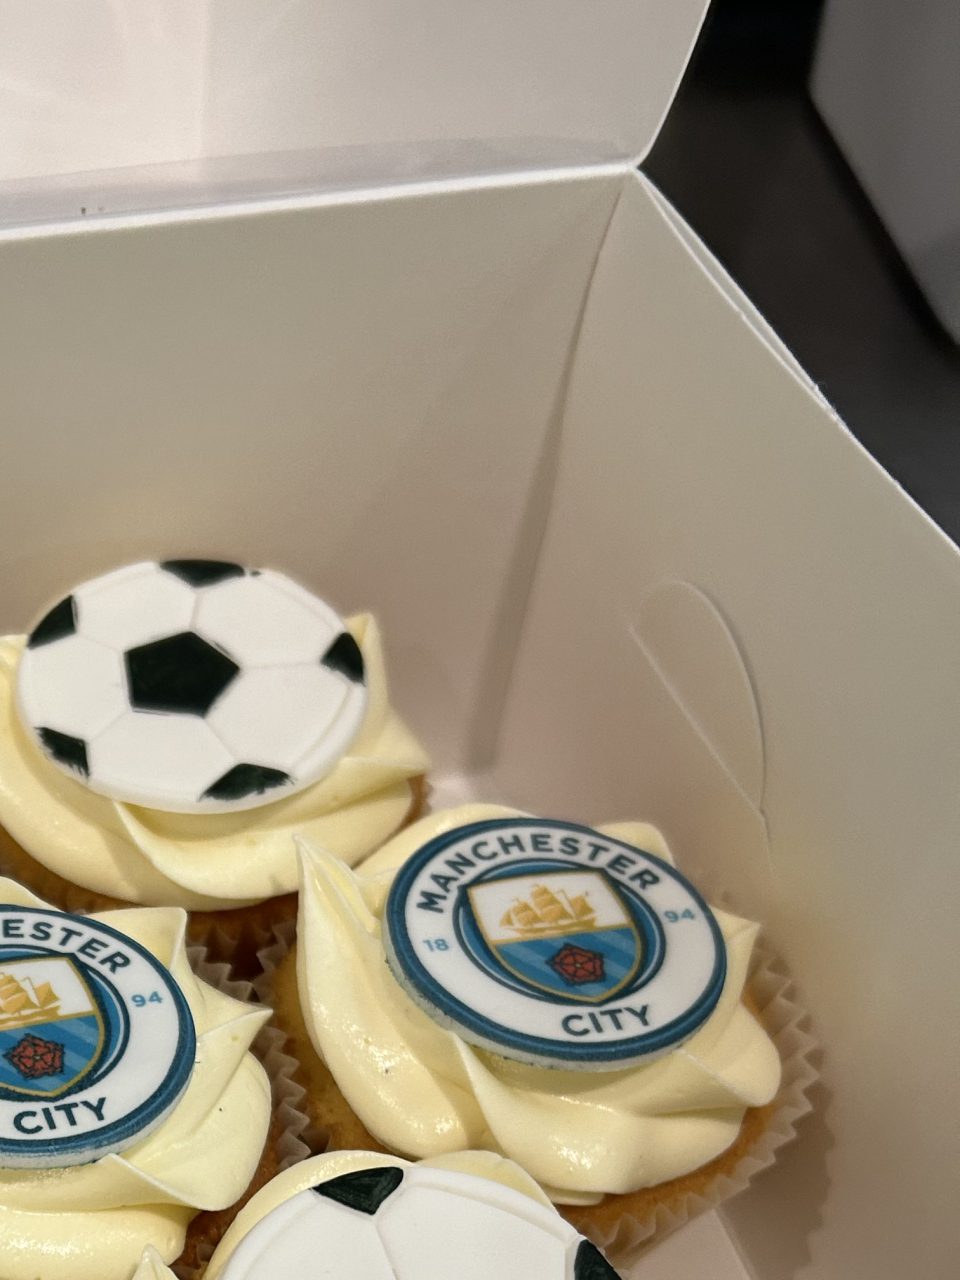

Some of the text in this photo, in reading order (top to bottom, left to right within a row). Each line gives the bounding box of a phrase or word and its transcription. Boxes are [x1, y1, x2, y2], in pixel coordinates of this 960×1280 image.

[417, 833, 661, 914] MANCHESTER
[664, 907, 696, 923] 94
[422, 937, 450, 953] 18
[131, 990, 164, 1008] 94
[561, 1004, 652, 1037] CITY
[13, 1097, 108, 1135] CITY
